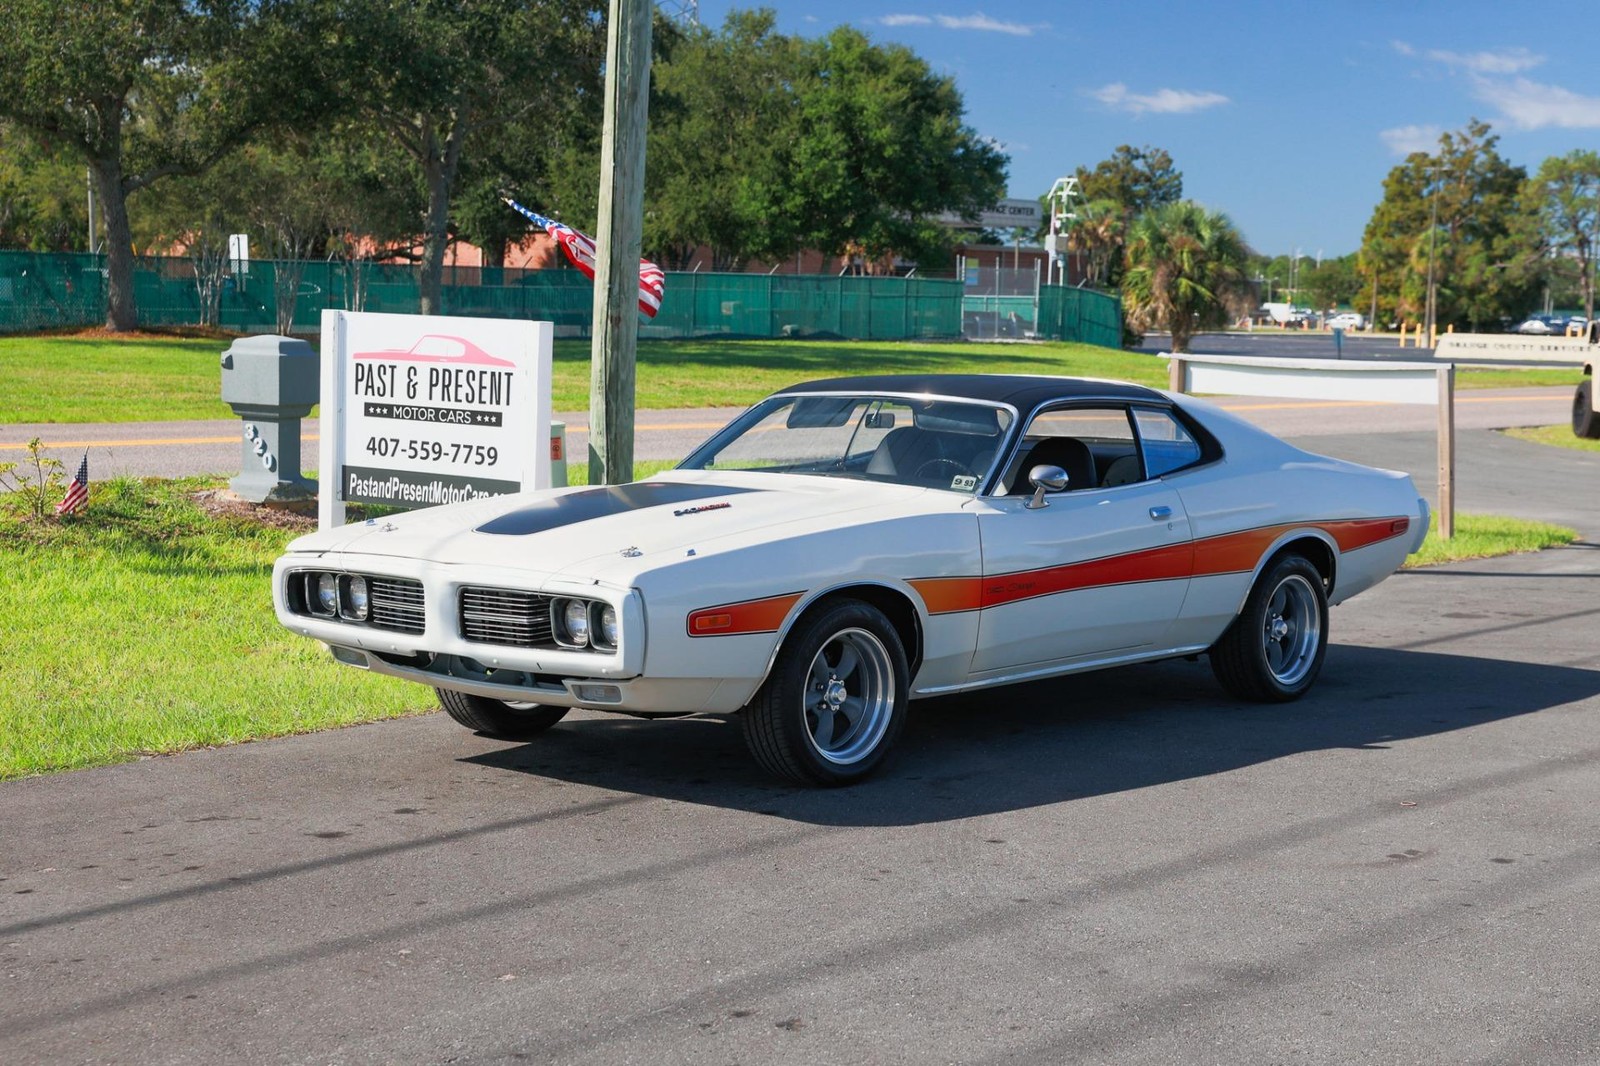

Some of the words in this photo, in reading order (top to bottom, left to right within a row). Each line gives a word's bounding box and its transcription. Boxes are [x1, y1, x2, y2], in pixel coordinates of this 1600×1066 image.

[1009, 206, 1034, 216] CENTER
[354, 363, 397, 398] PAST
[406, 366, 419, 399] &
[429, 368, 514, 406] PRESENT
[393, 406, 435, 421] MOTOR
[438, 410, 472, 424] CARS
[366, 437, 498, 466] 407-559-7759
